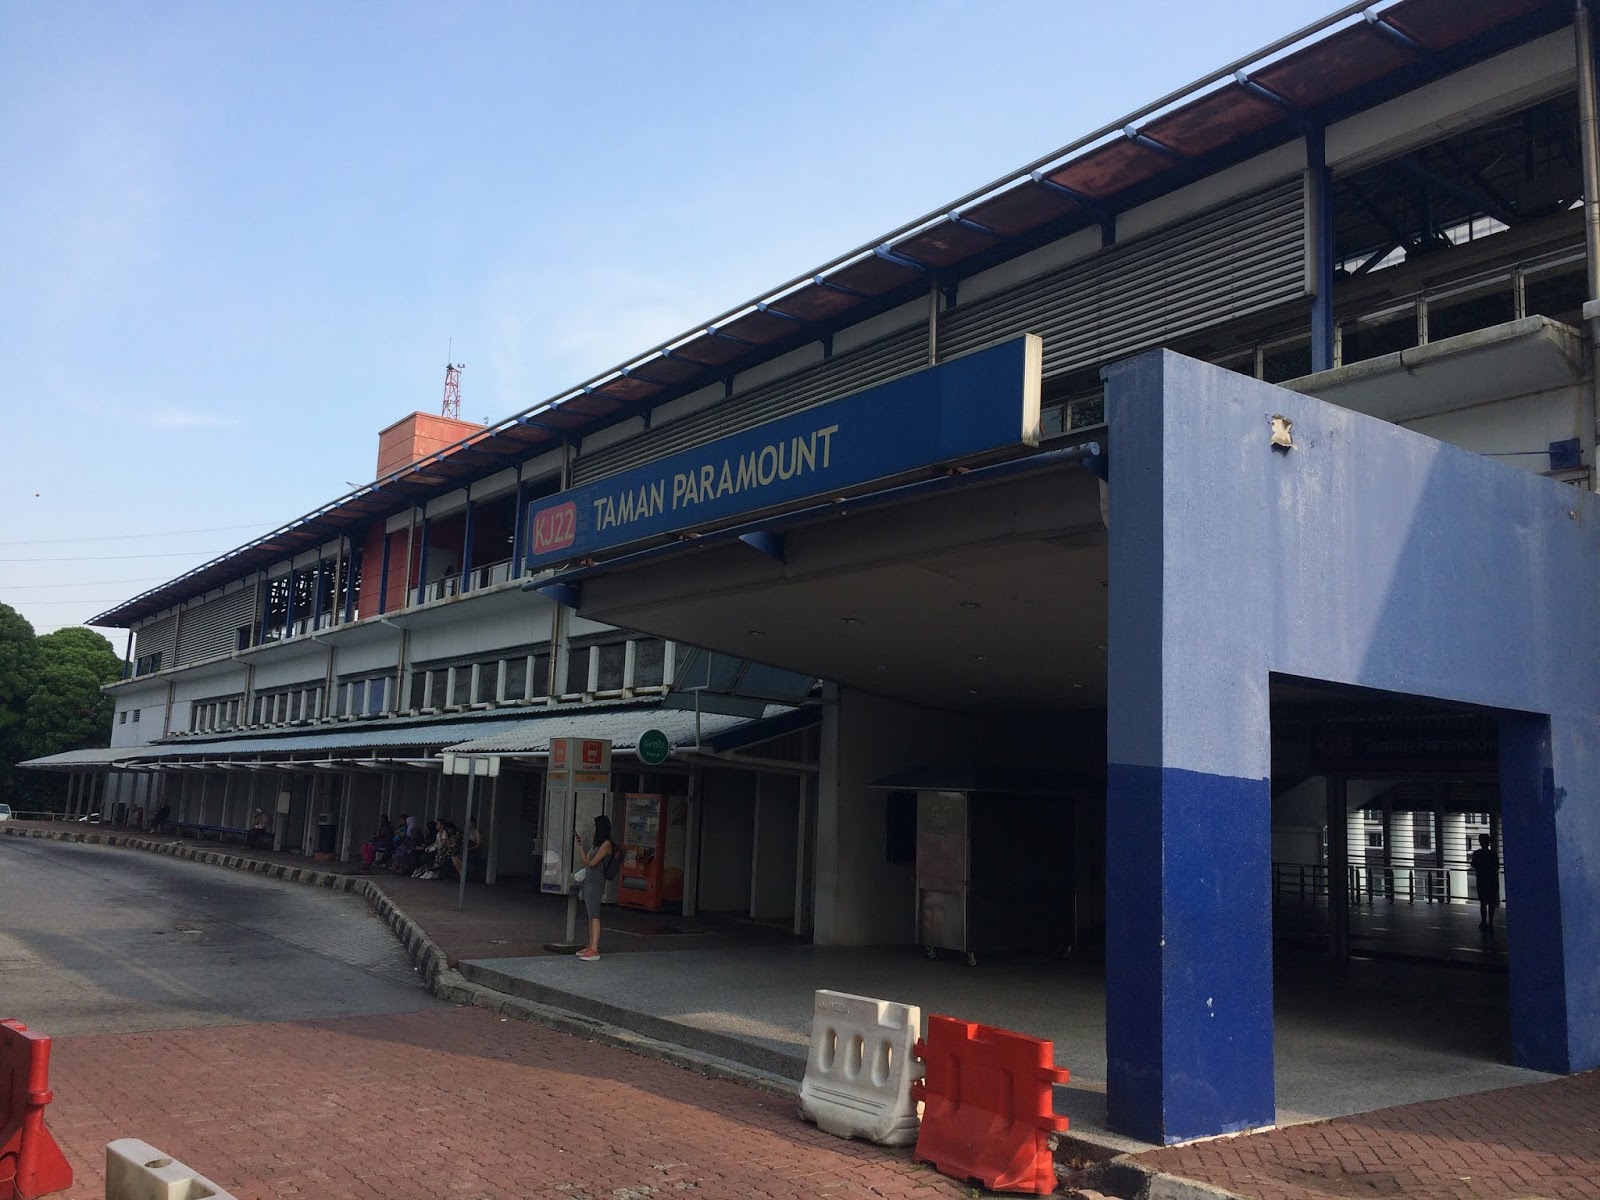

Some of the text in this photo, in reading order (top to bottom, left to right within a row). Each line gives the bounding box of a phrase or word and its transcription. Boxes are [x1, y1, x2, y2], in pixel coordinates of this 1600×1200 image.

[534, 424, 839, 550] KJ22 TAMAN PARAMOUNT
[643, 739, 664, 749] Grab
